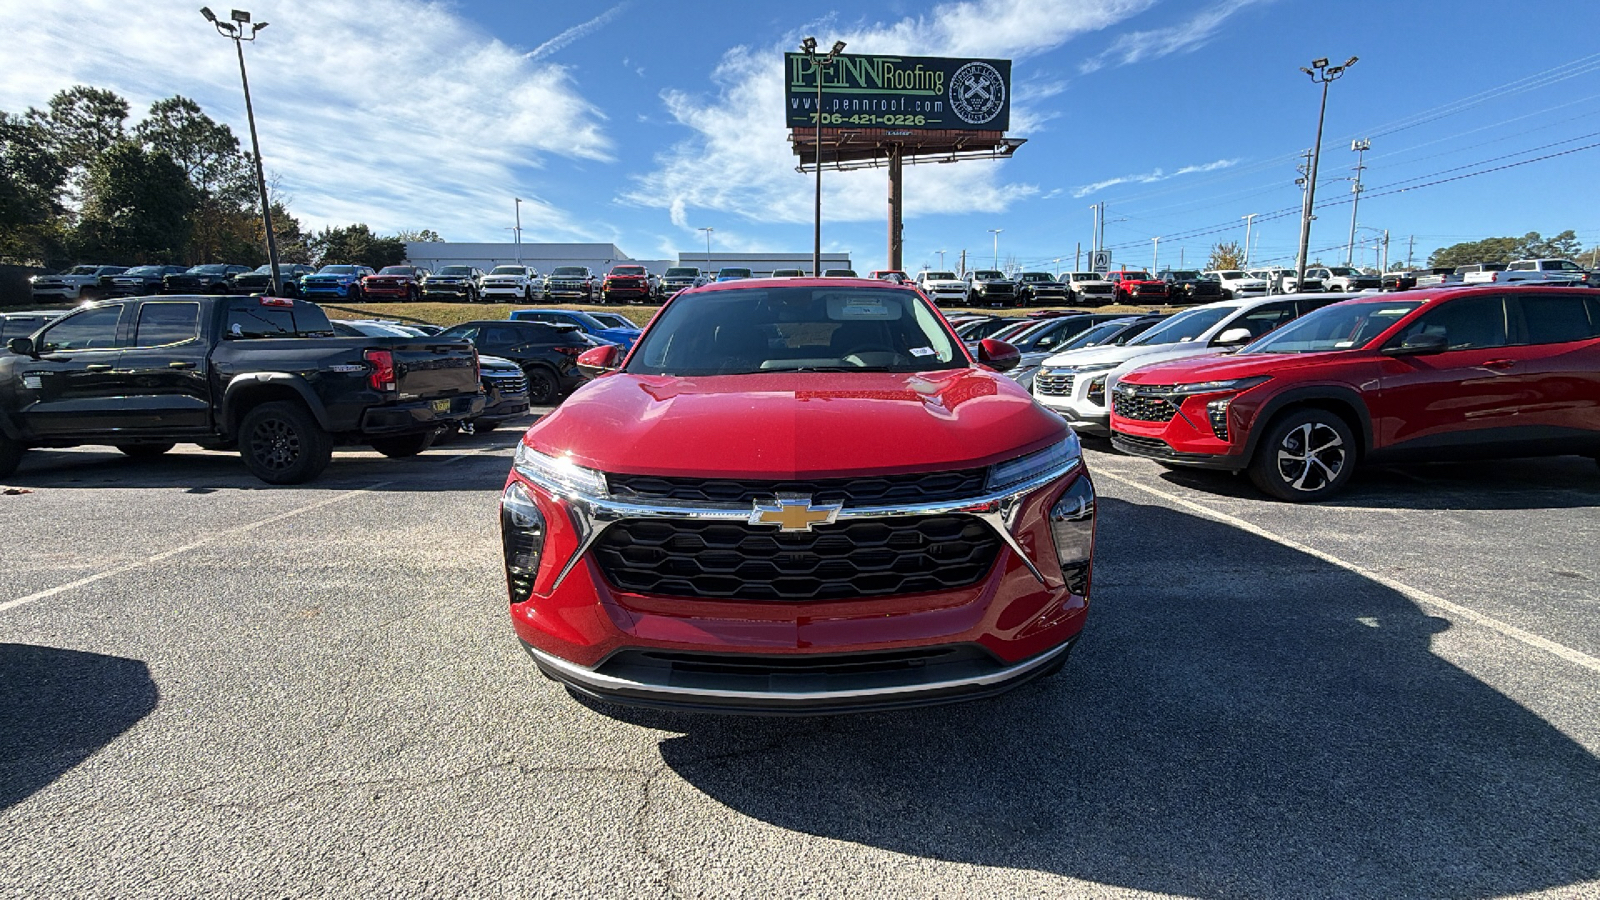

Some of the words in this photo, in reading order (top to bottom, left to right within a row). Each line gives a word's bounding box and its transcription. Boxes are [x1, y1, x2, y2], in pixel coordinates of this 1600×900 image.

[790, 55, 901, 87] PENN
[884, 63, 944, 95] Roofing
[953, 67, 982, 90] SUPPORT
[982, 68, 1002, 90] LOCAL
[809, 113, 925, 125] 706-421-0226
